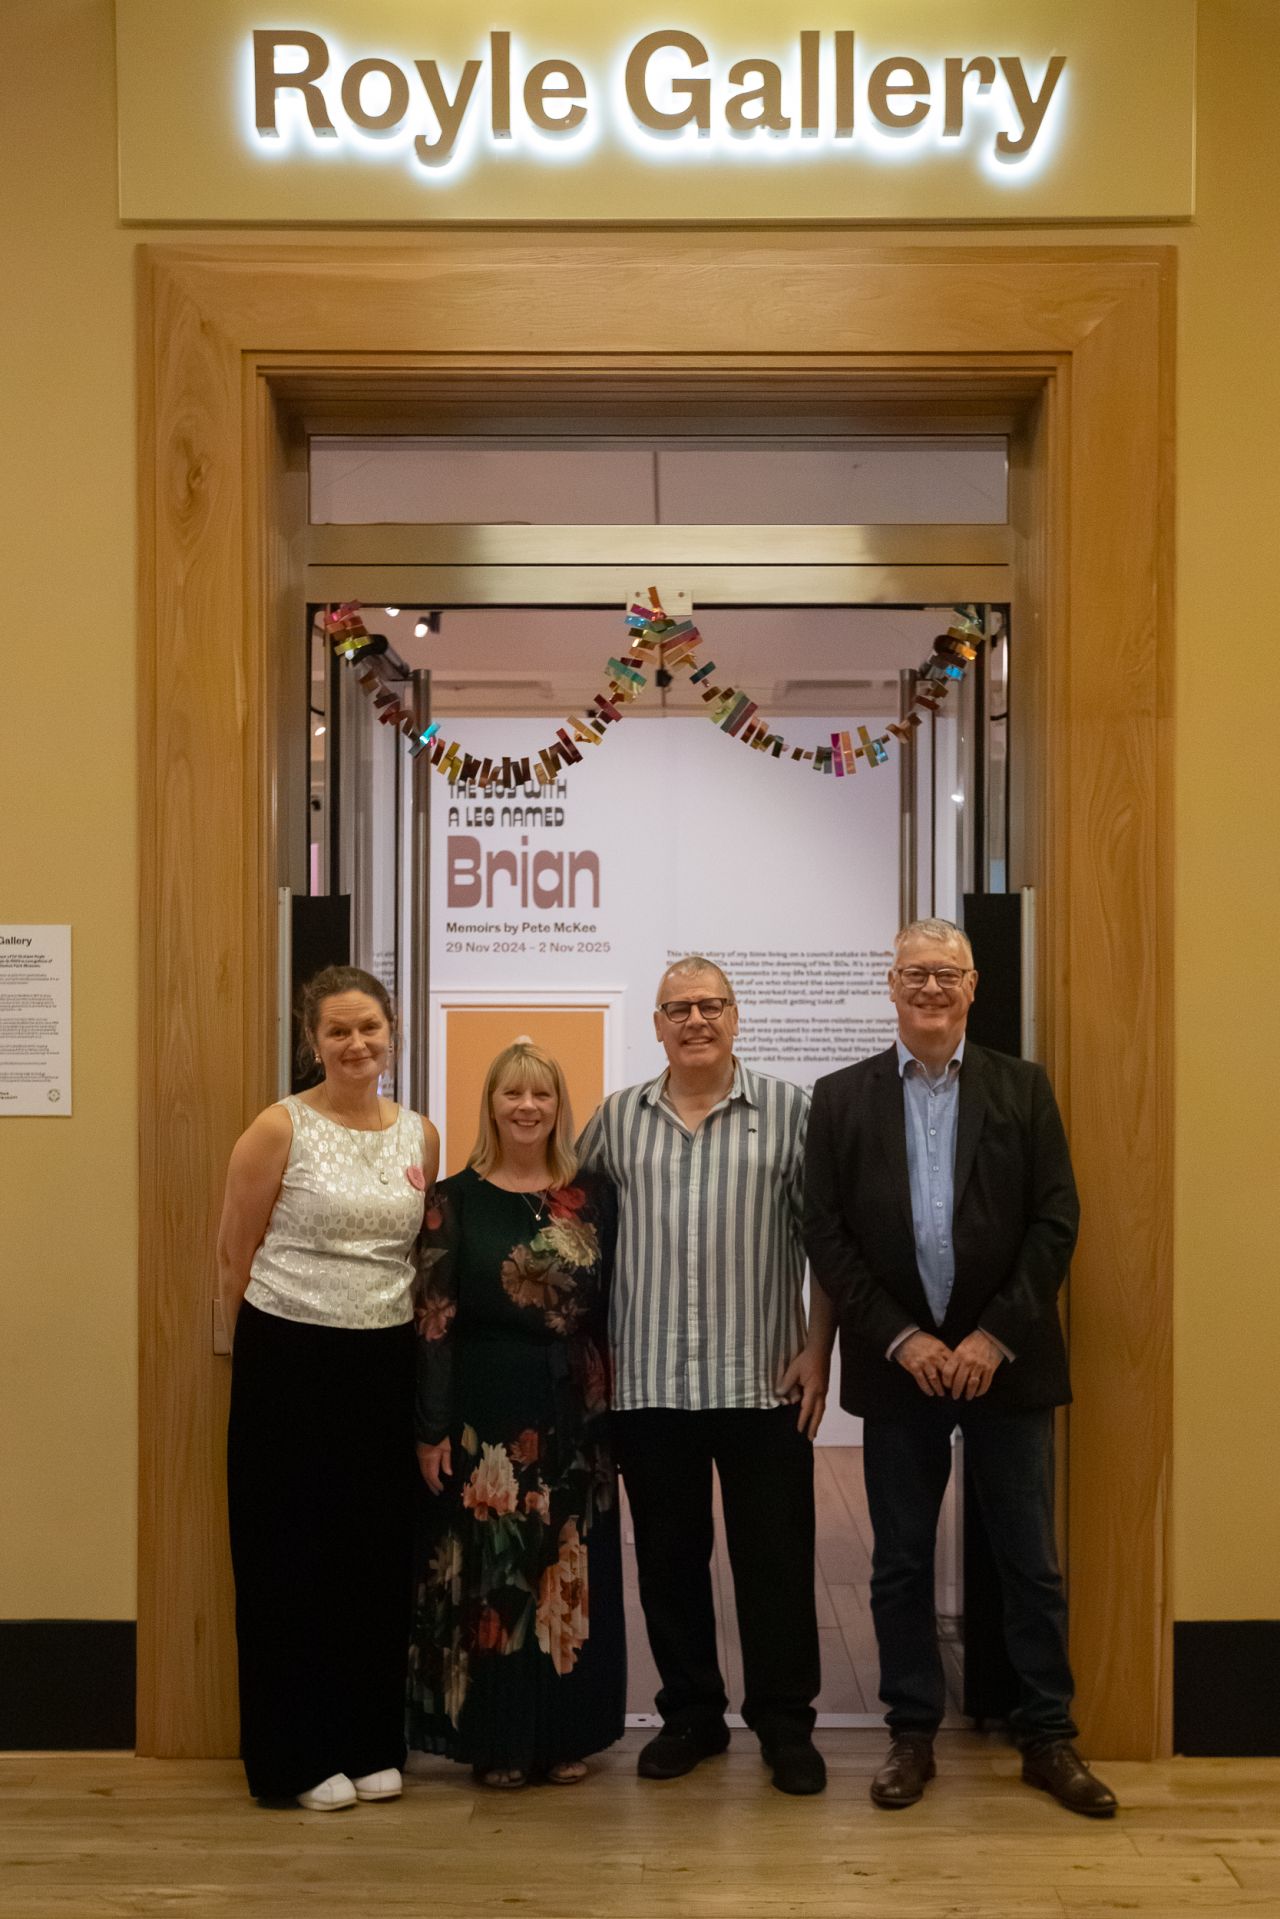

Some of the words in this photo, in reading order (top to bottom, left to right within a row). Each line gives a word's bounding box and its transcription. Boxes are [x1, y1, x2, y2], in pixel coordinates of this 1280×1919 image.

[252, 29, 588, 168] Royle
[624, 29, 1067, 164] Gallery
[448, 806, 460, 828] A
[466, 806, 495, 828] LEG
[501, 806, 565, 828] NAMED
[447, 835, 600, 910] Brian
[446, 921, 501, 934] Memoirs
[504, 921, 518, 936] by
[522, 921, 550, 934] Pete
[553, 921, 597, 934] McKee
[446, 941, 462, 953] 29
[465, 941, 489, 953] Nov
[493, 941, 526, 953] 2024
[539, 941, 547, 953] 2
[550, 941, 574, 953] Nov
[577, 941, 611, 953] 2025
